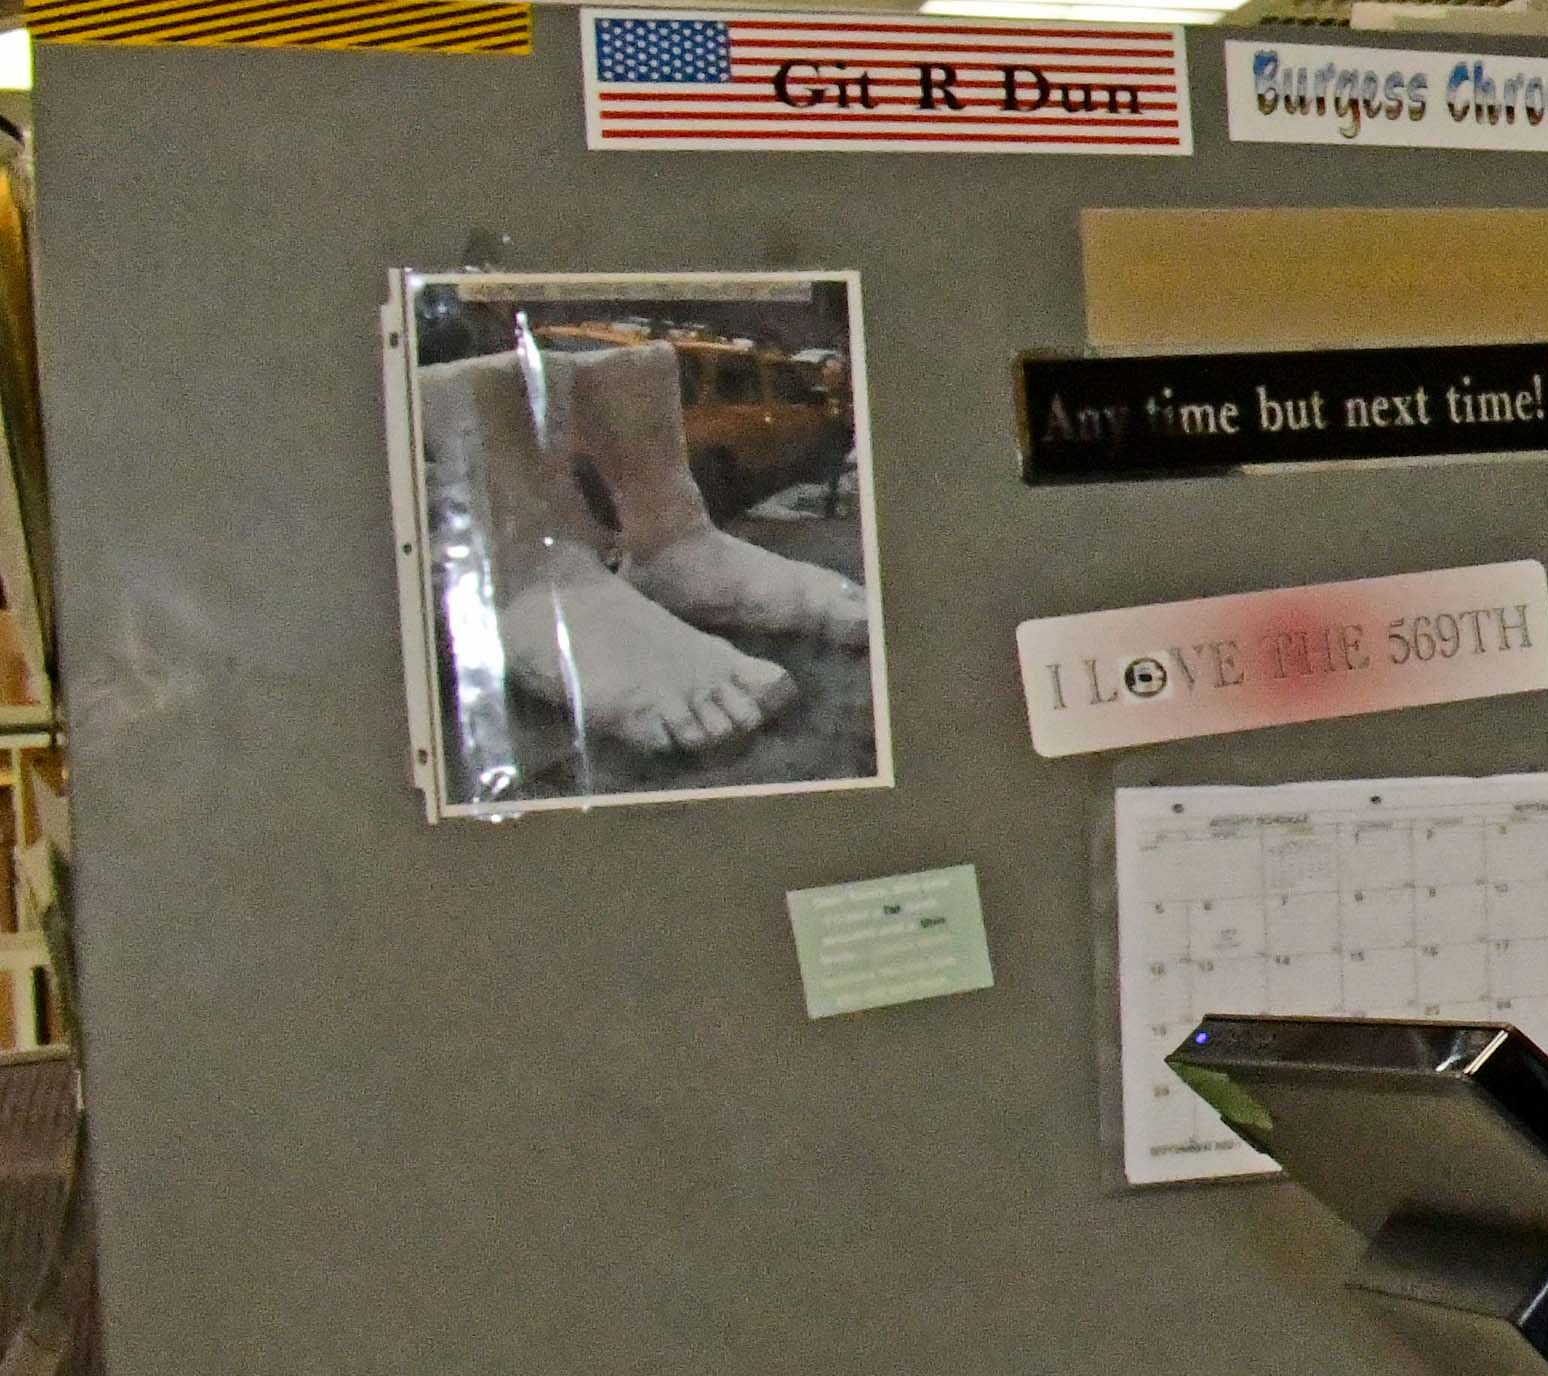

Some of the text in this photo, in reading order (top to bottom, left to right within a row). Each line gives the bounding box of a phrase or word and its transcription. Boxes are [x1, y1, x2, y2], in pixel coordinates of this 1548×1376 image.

[772, 58, 1143, 115] Git R Dun
[1253, 50, 1428, 139] Burgess
[1256, 384, 1328, 432] but
[1344, 385, 1431, 428] next
[1445, 374, 1545, 424] time!
[1045, 663, 1070, 711] I
[1260, 624, 1371, 680] THE
[1388, 604, 1533, 665] 569TH
